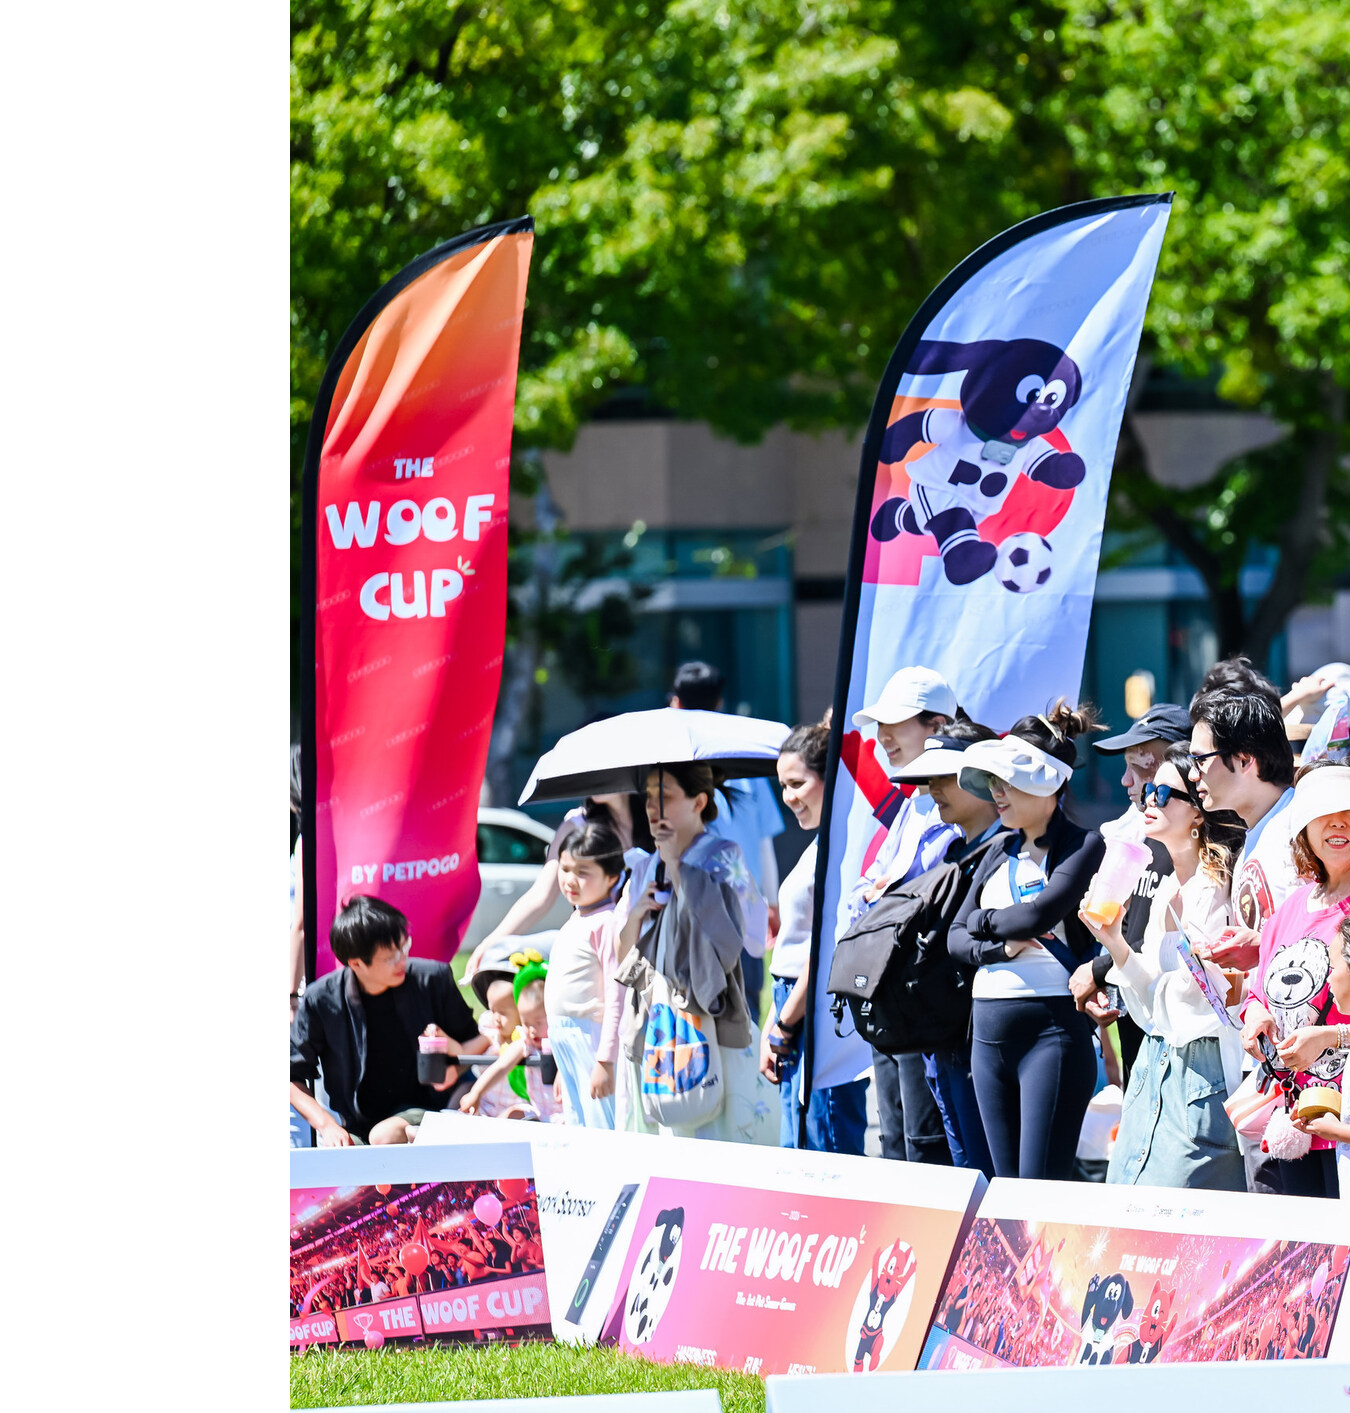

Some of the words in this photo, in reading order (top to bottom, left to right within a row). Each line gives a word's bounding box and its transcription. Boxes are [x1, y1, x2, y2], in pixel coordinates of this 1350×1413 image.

[394, 457, 434, 479] THE
[325, 493, 495, 549] WOOF
[359, 568, 464, 621] CUP
[351, 864, 378, 885] BY
[382, 852, 460, 883] PETPOGO
[700, 1222, 748, 1275] THE
[744, 1226, 820, 1285] WOOF
[813, 1235, 862, 1290] CUP
[1119, 1254, 1137, 1272] THE
[1135, 1255, 1163, 1274] WOOF
[1160, 1258, 1178, 1276] CUP
[378, 1305, 416, 1330] THE
[420, 1295, 480, 1326] WOOF
[486, 1287, 543, 1320] CUP
[311, 1320, 335, 1338] CUP
